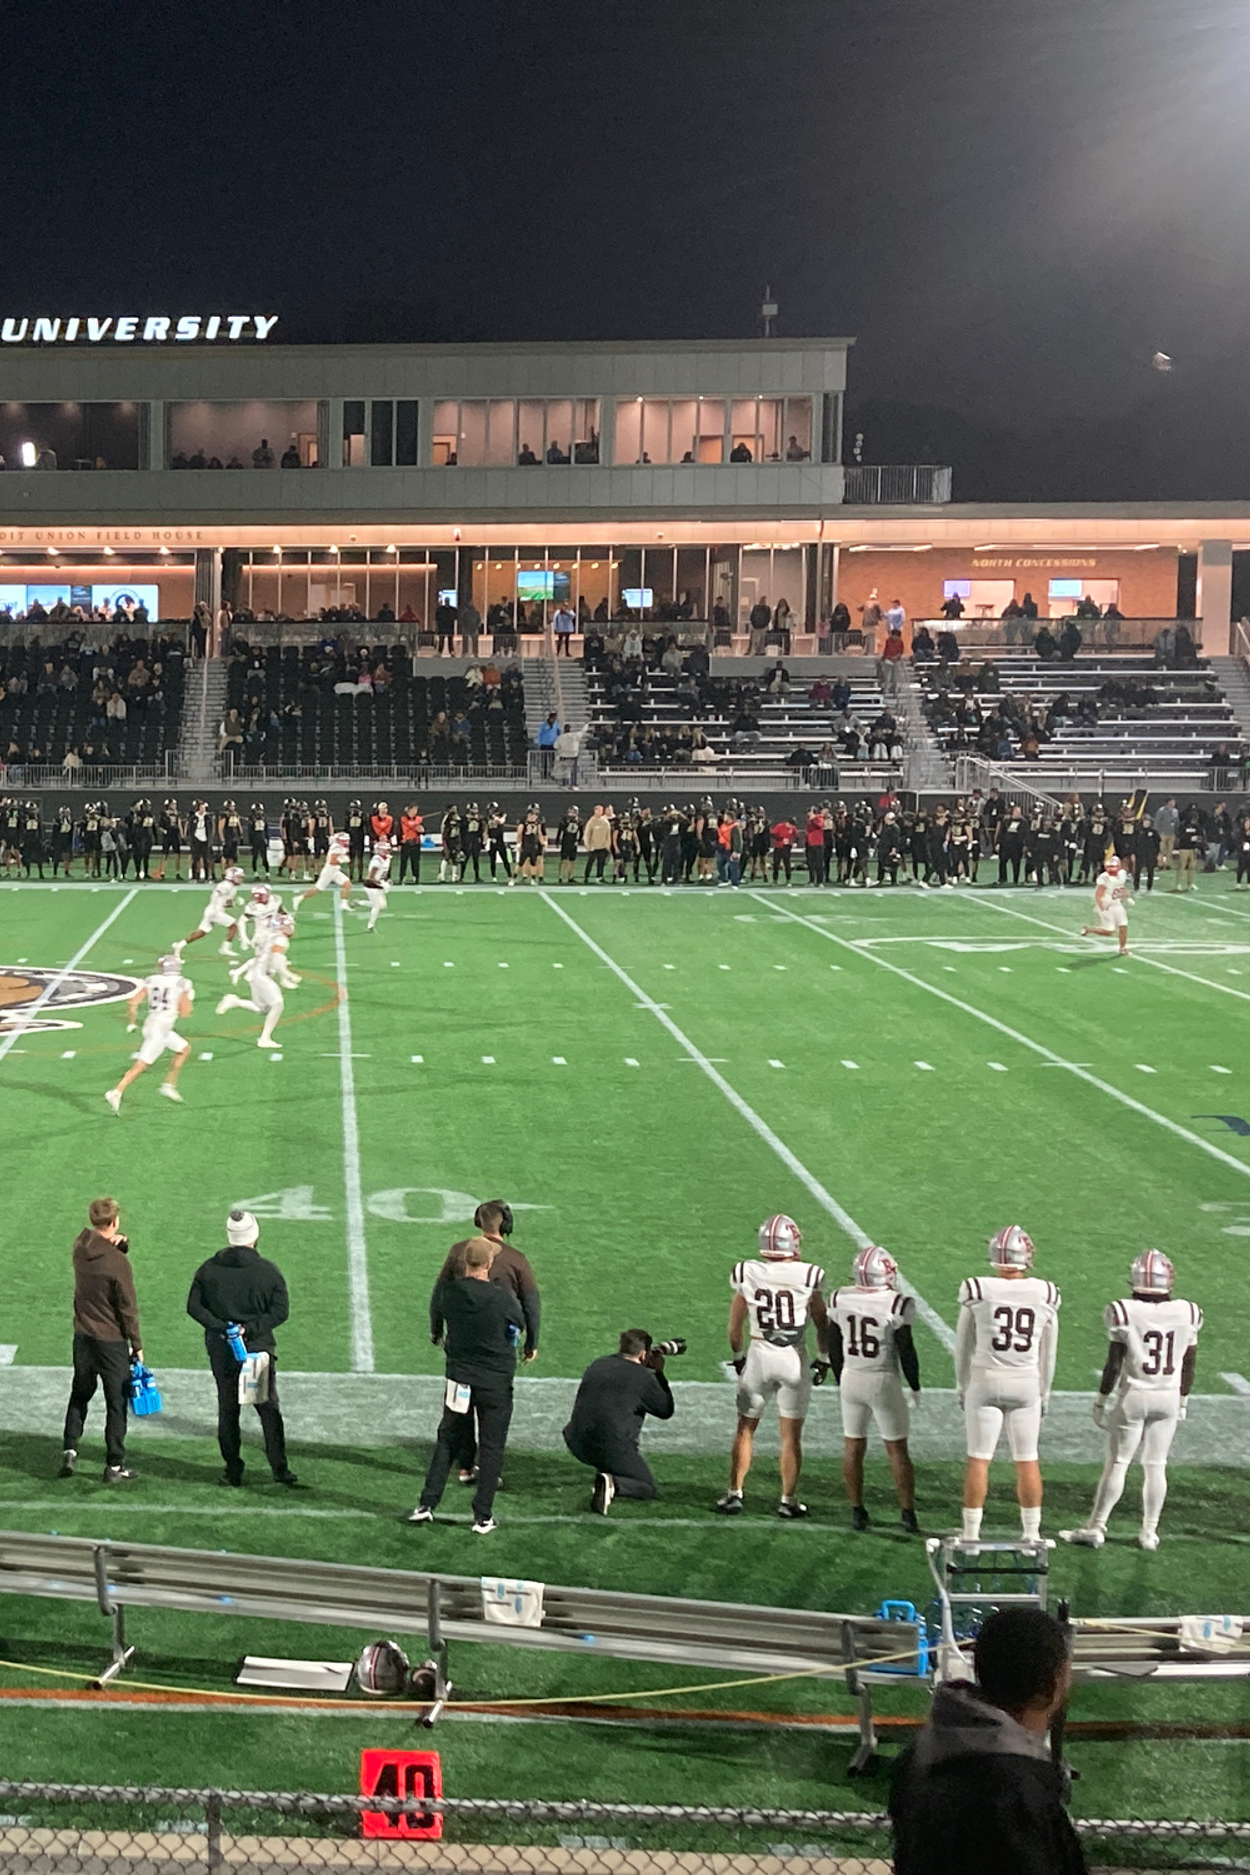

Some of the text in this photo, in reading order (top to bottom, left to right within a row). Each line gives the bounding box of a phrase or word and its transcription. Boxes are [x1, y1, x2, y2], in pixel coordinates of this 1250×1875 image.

[1, 316, 278, 341] UNIVERSITY
[35, 531, 86, 541] UNION
[97, 531, 142, 541] FIELD
[153, 531, 203, 541] HOUSE
[971, 558, 1097, 567] NORTH CONCESSIONS
[231, 1185, 484, 1222] 40
[755, 1289, 796, 1330] 20
[992, 1306, 1036, 1352] 39
[847, 1315, 879, 1358] 16
[1143, 1331, 1176, 1375] 31
[373, 1764, 436, 1828] 40
